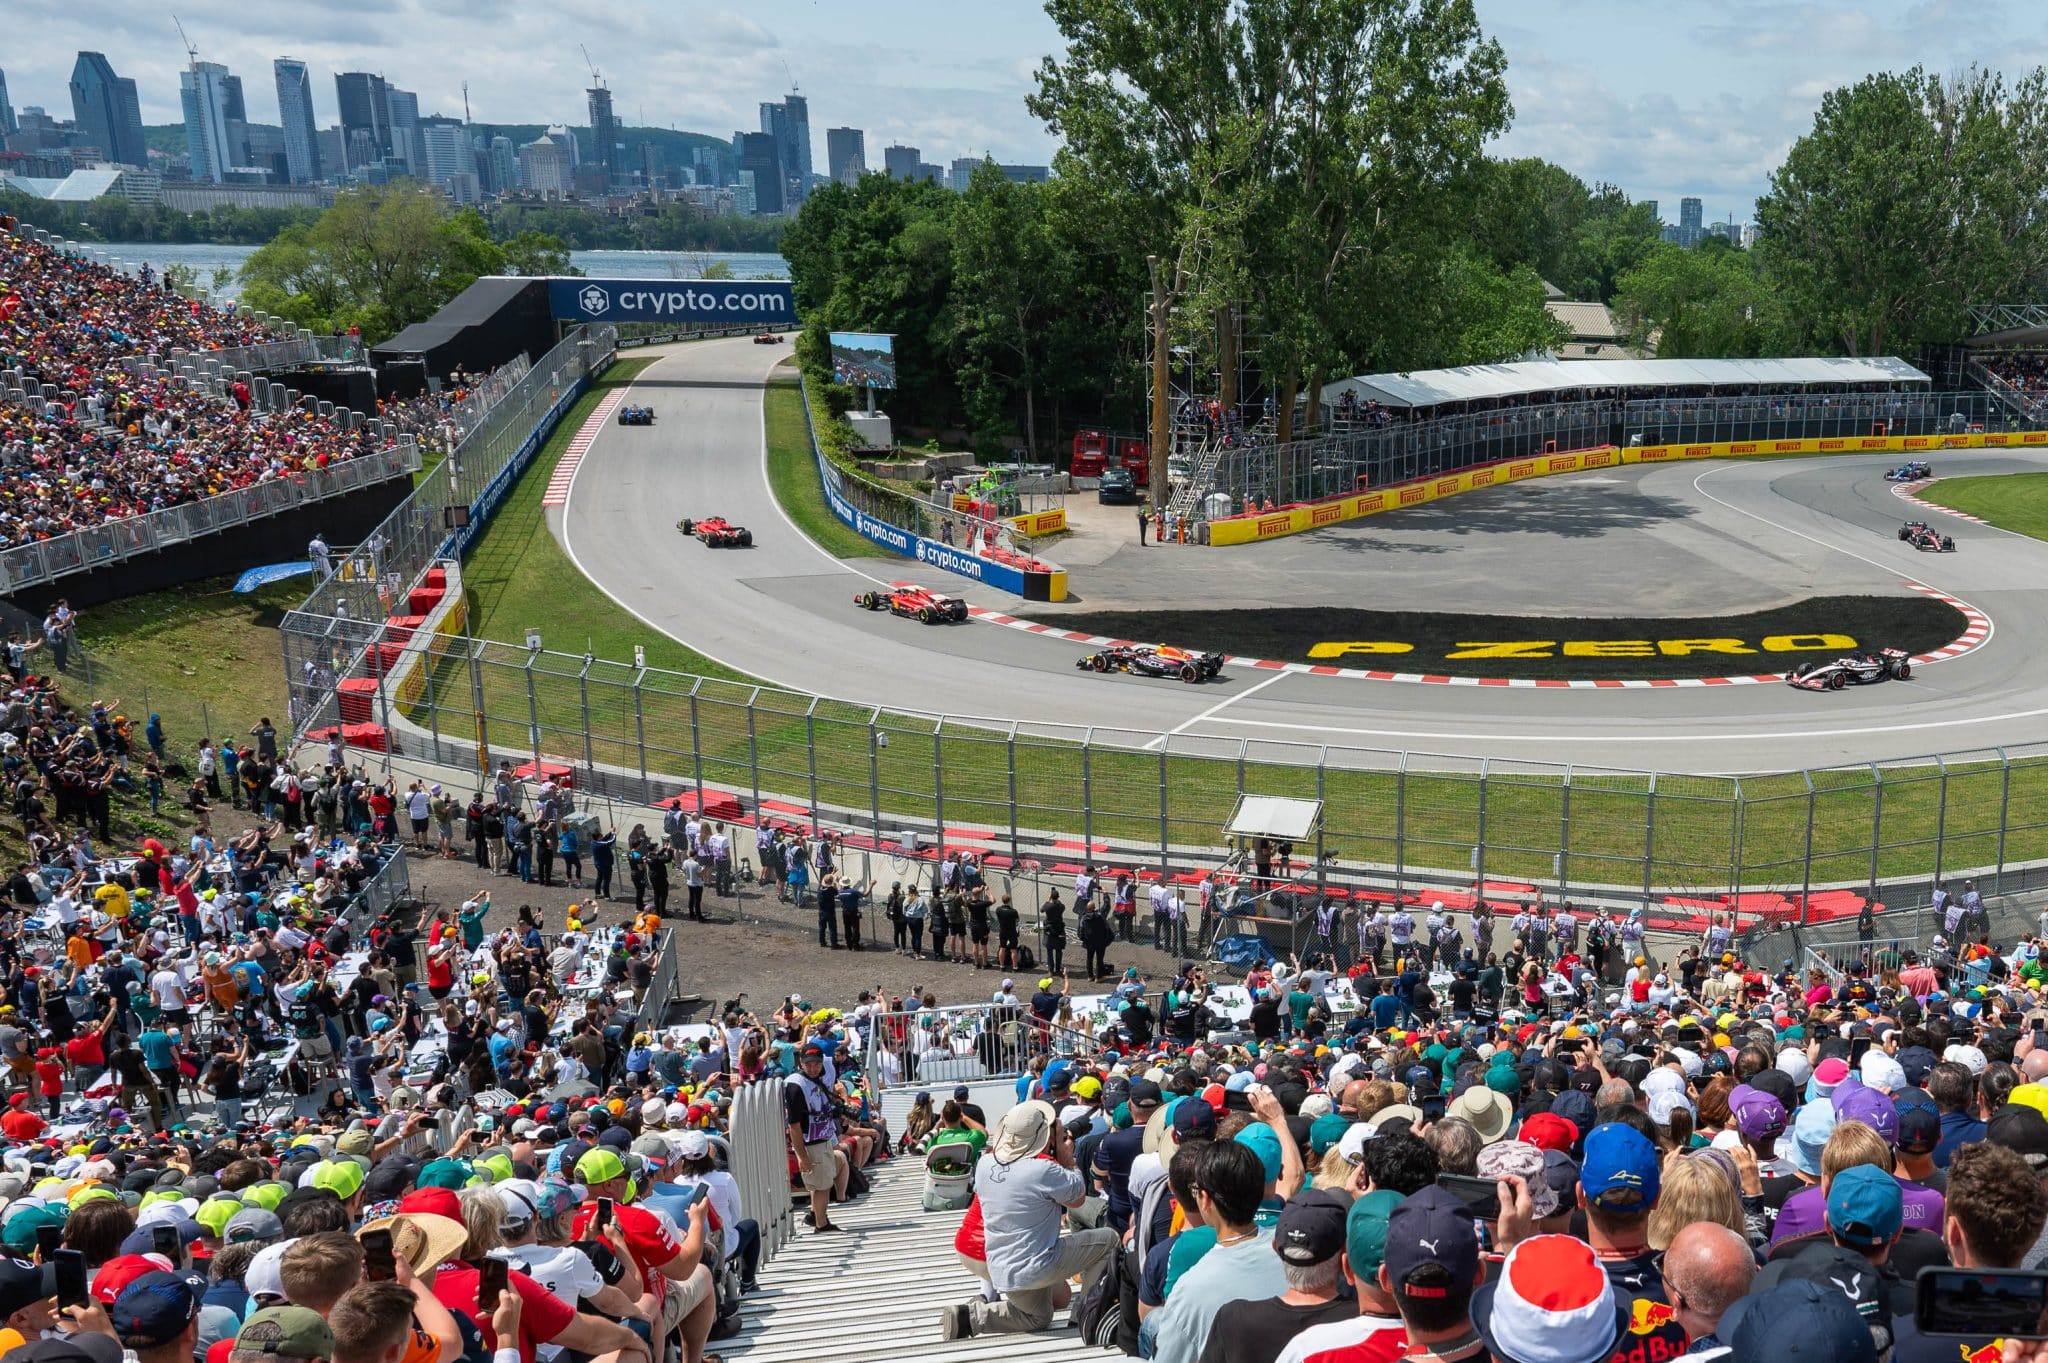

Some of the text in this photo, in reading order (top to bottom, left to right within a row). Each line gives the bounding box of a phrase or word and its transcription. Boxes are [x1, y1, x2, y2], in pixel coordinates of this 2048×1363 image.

[619, 289, 785, 314] crypto.com
[1549, 457, 1576, 471] PIRELLI
[1584, 452, 1611, 466] PIRELLI
[1472, 471, 1494, 486] PIRELLI
[1509, 463, 1534, 478] PIRELLI
[1400, 487, 1425, 504] PIRELLI
[1437, 479, 1459, 495] PIRELLI
[1358, 495, 1384, 513] PIRELLI
[1036, 513, 1062, 531] PIRELLI
[1312, 505, 1341, 524] PIRELLI
[863, 520, 907, 549] crypto.com
[1258, 516, 1290, 536] PIRELLI
[927, 546, 982, 577] crypto.com
[1307, 642, 1414, 658] P
[1445, 634, 1857, 659] ZERO
